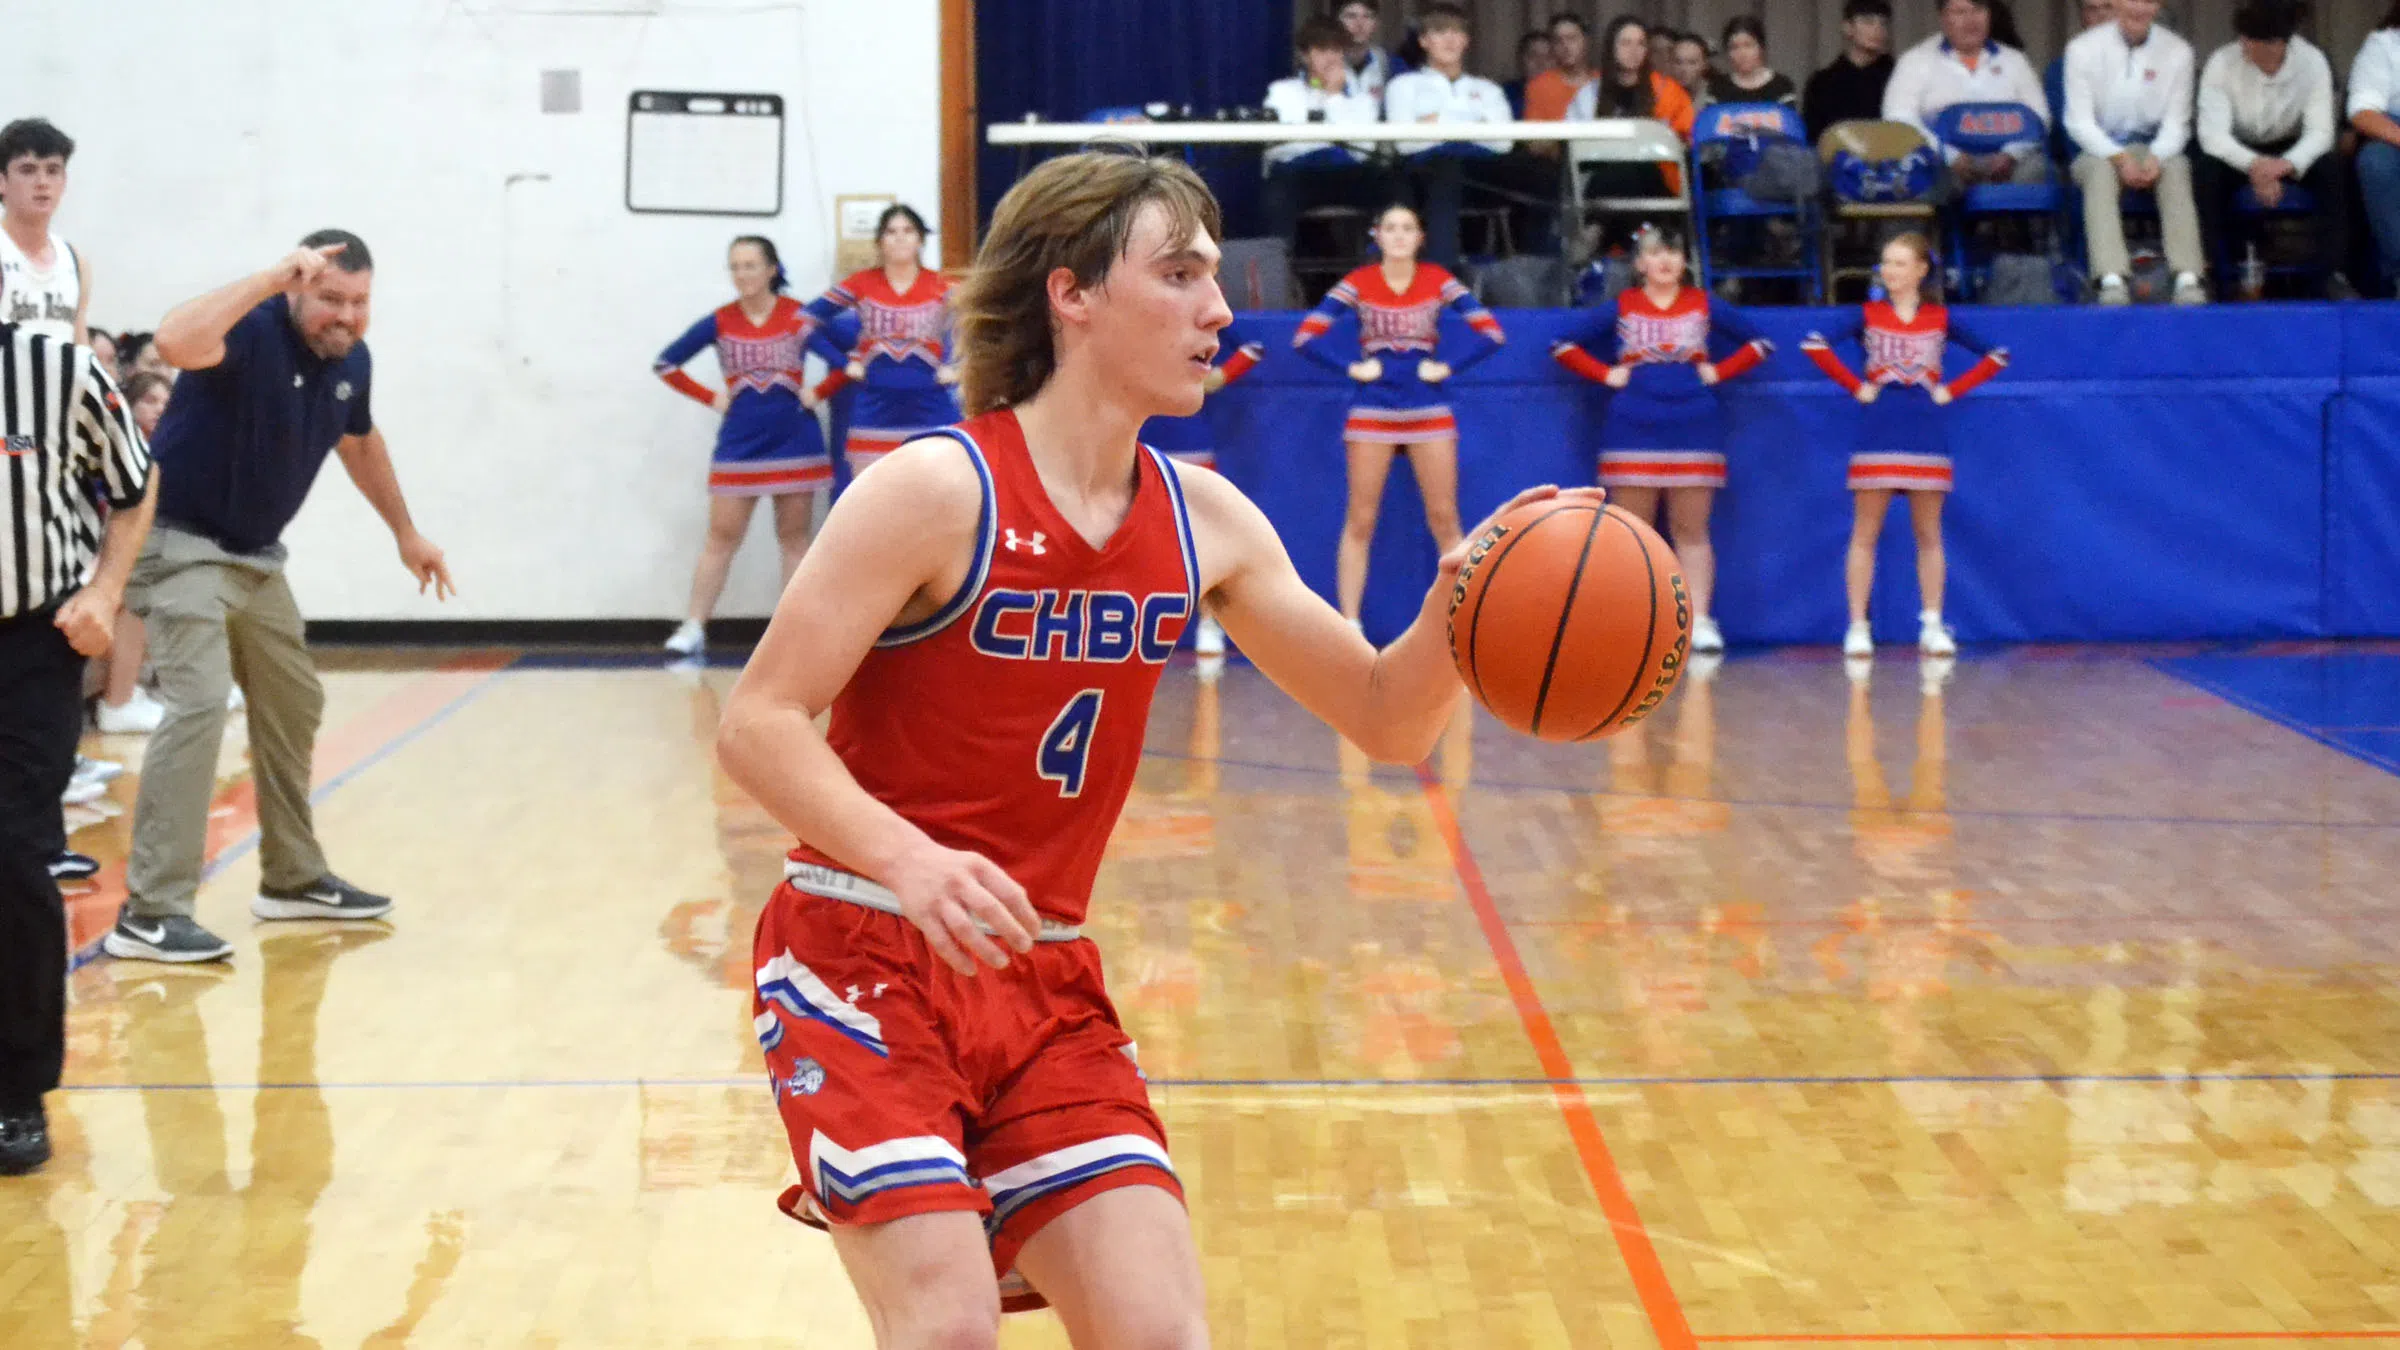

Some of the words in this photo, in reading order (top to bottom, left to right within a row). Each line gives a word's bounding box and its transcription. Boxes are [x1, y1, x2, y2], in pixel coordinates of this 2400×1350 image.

[969, 587, 1188, 664] CHBC
[1620, 573, 1689, 726] Wilson
[1036, 688, 1104, 798] 4
